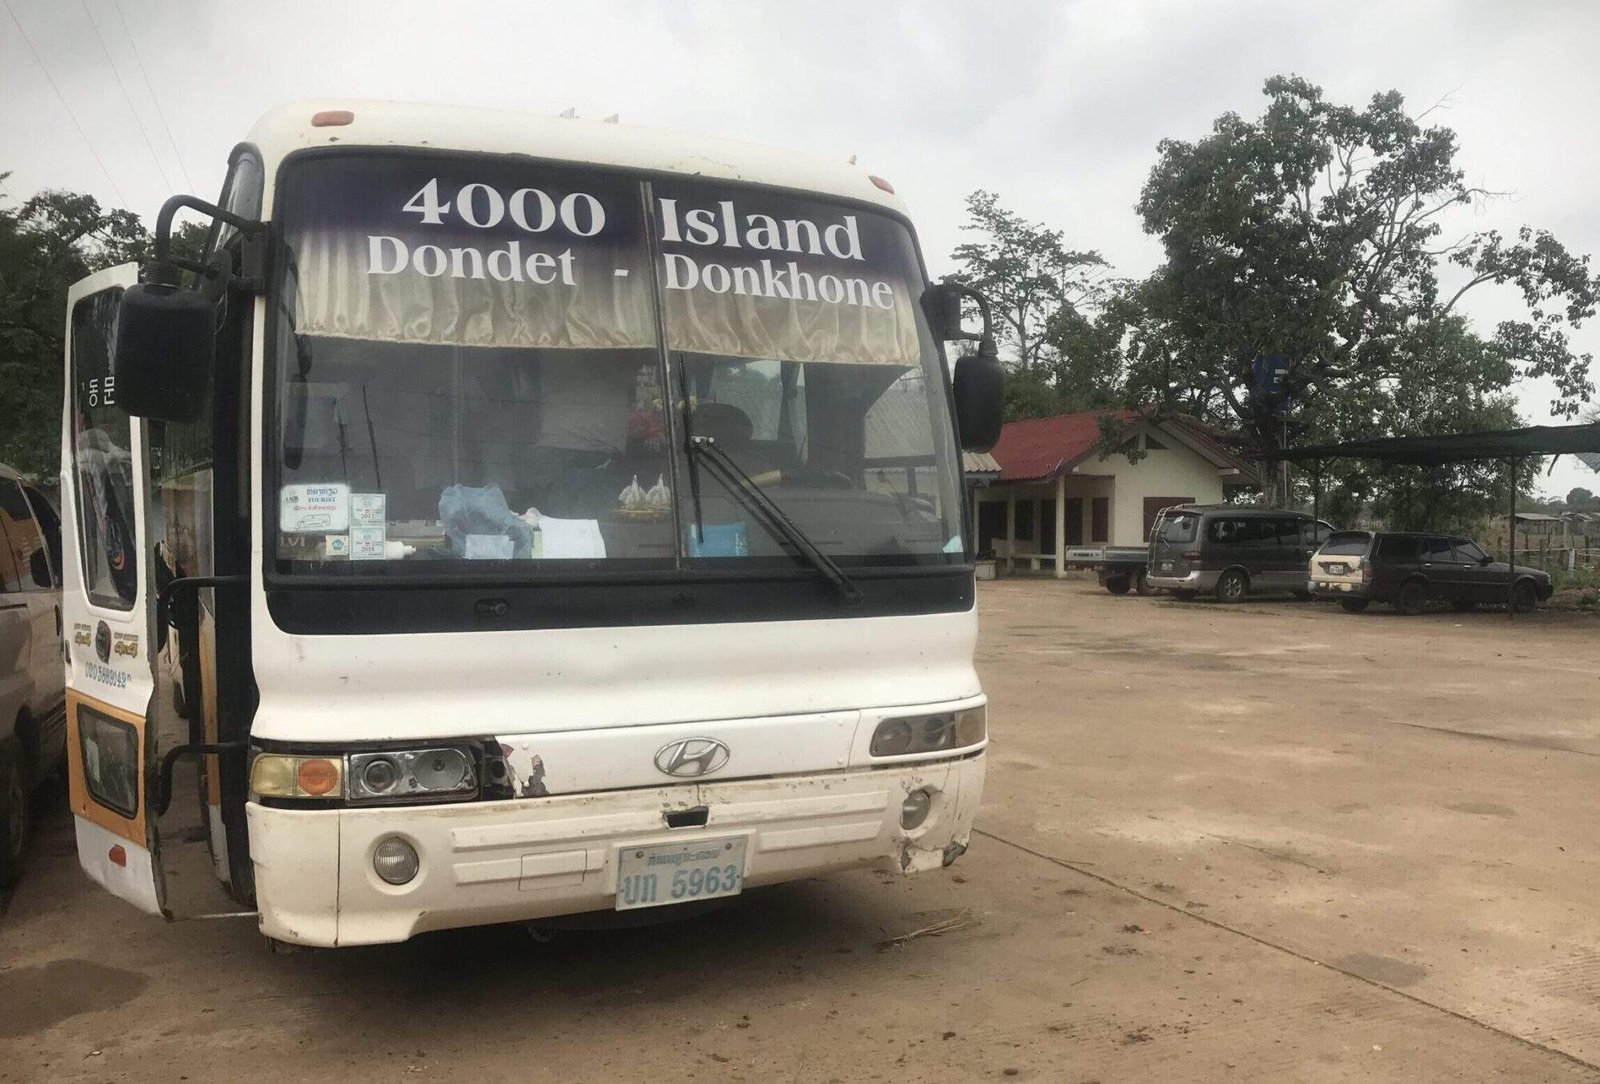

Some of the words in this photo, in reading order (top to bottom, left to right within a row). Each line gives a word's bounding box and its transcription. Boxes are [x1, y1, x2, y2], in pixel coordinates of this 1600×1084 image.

[402, 177, 606, 237] 4000
[658, 197, 866, 262] Island
[367, 234, 577, 287] Dondet
[664, 253, 896, 310] Donkhone
[81, 376, 115, 407] 동문
[671, 864, 737, 899] 5963
